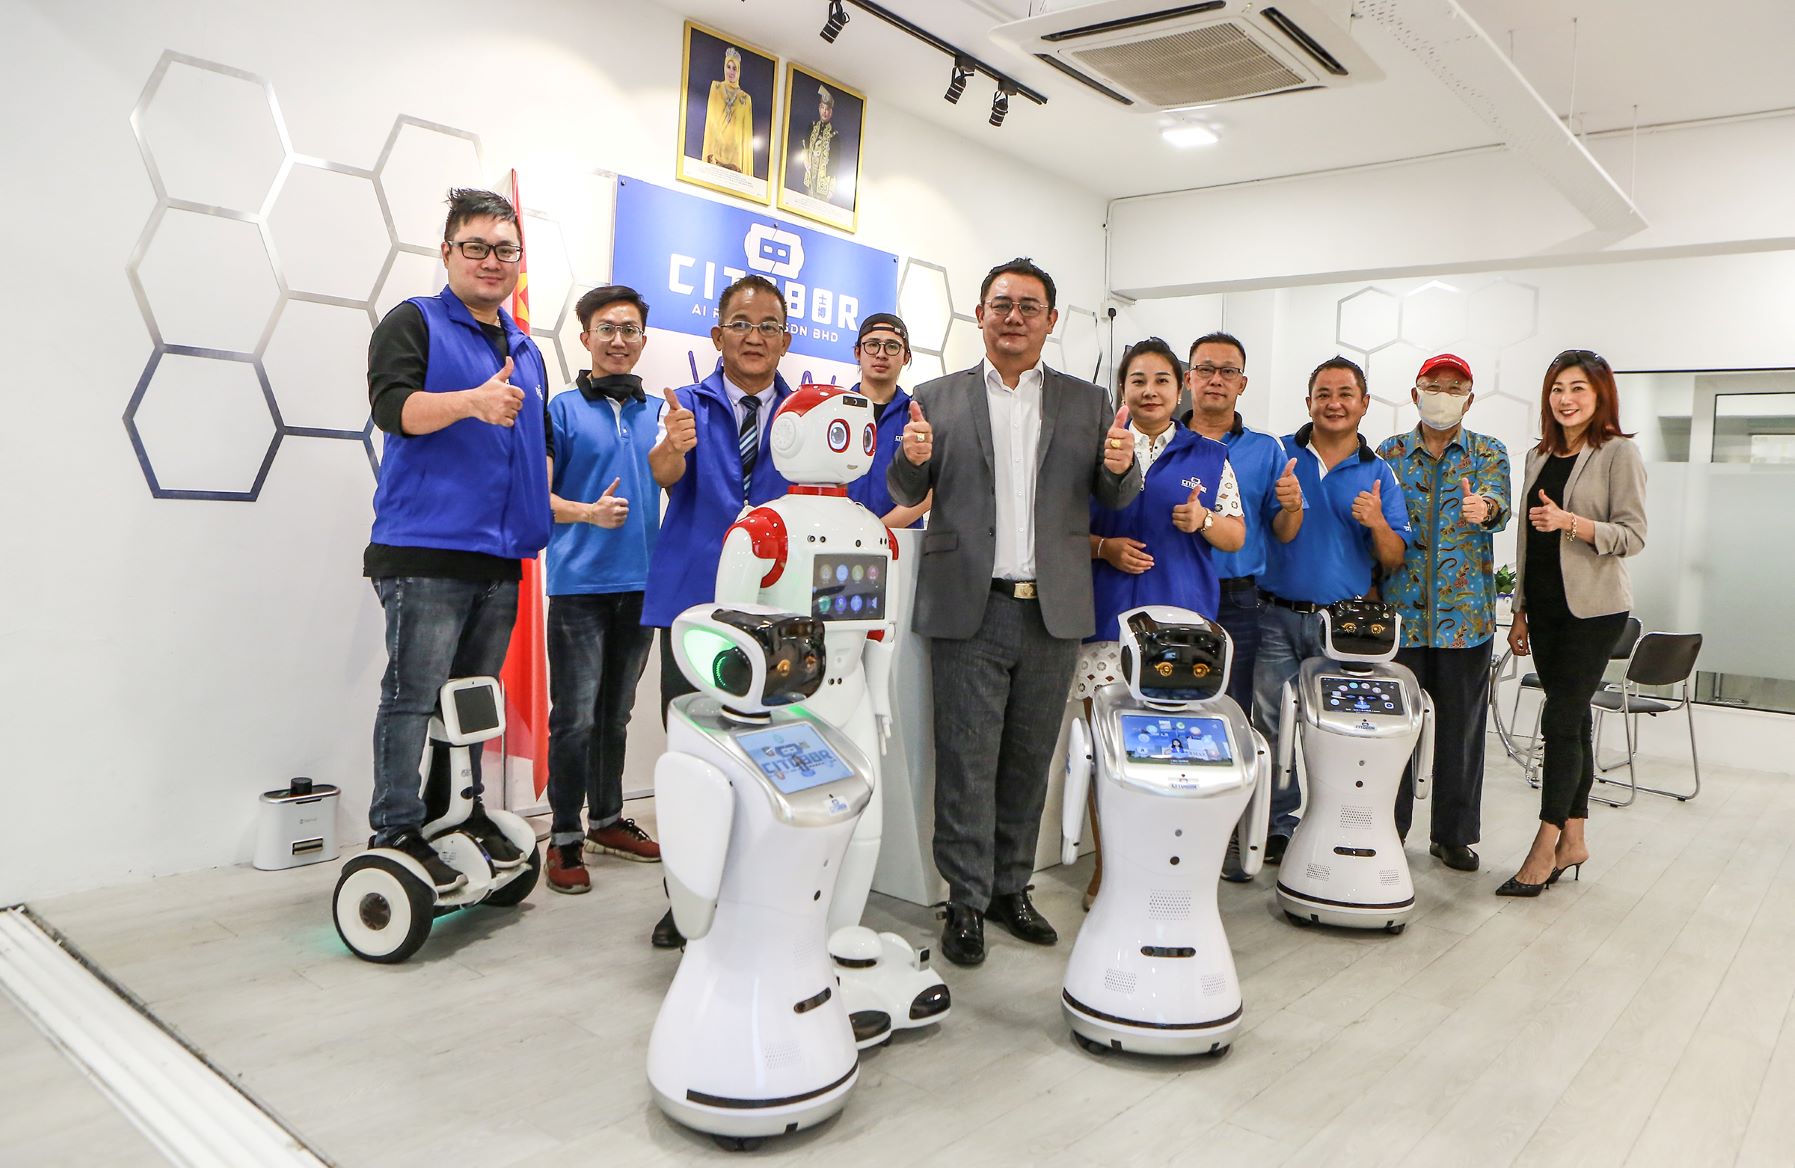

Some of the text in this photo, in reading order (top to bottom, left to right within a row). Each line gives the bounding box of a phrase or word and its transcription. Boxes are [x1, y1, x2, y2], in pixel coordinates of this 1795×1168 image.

[669, 253, 859, 332] CITBOR
[691, 303, 707, 316] AI
[812, 328, 839, 342] BHD
[1181, 479, 1207, 493] CITOR
